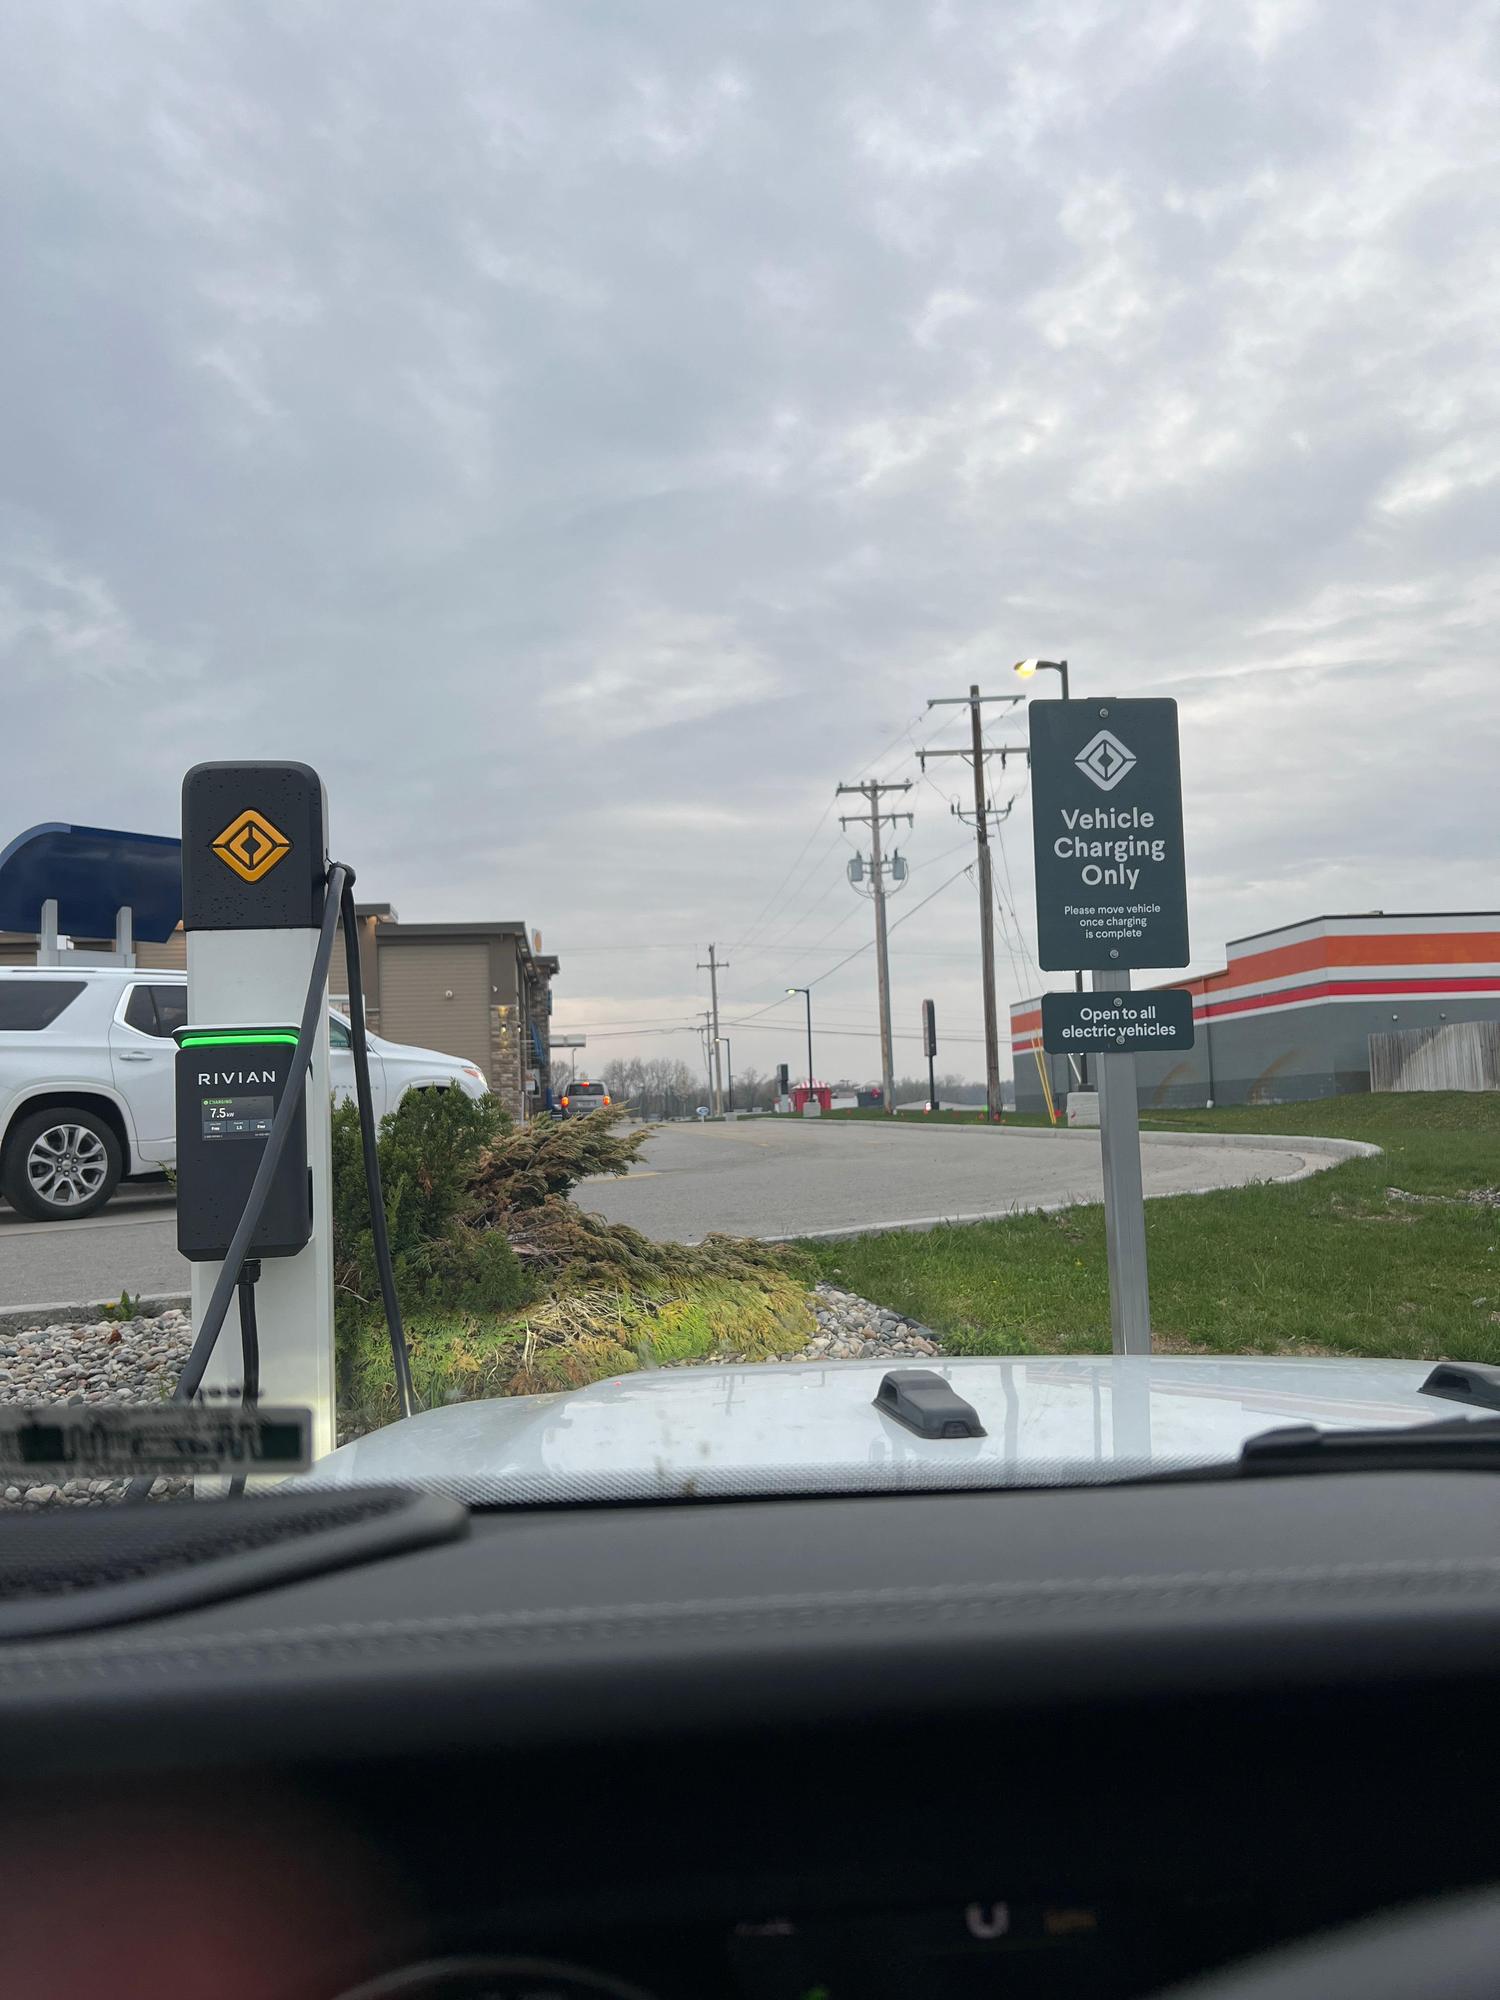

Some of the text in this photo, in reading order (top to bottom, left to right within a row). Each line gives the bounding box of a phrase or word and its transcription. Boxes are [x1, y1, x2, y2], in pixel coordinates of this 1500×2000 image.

[1060, 807, 1154, 830] Vehicle
[1053, 835, 1166, 862] Charging
[1081, 863, 1140, 890] Only
[1064, 903, 1161, 915] Please move vehicle
[1079, 916, 1147, 928] once charging
[1085, 928, 1142, 940] is complete
[1080, 1005, 1156, 1024] Open to all
[1062, 1022, 1176, 1038] electric vehicles
[198, 1071, 276, 1085] RIVIAN
[210, 1108, 226, 1118] 7.5
